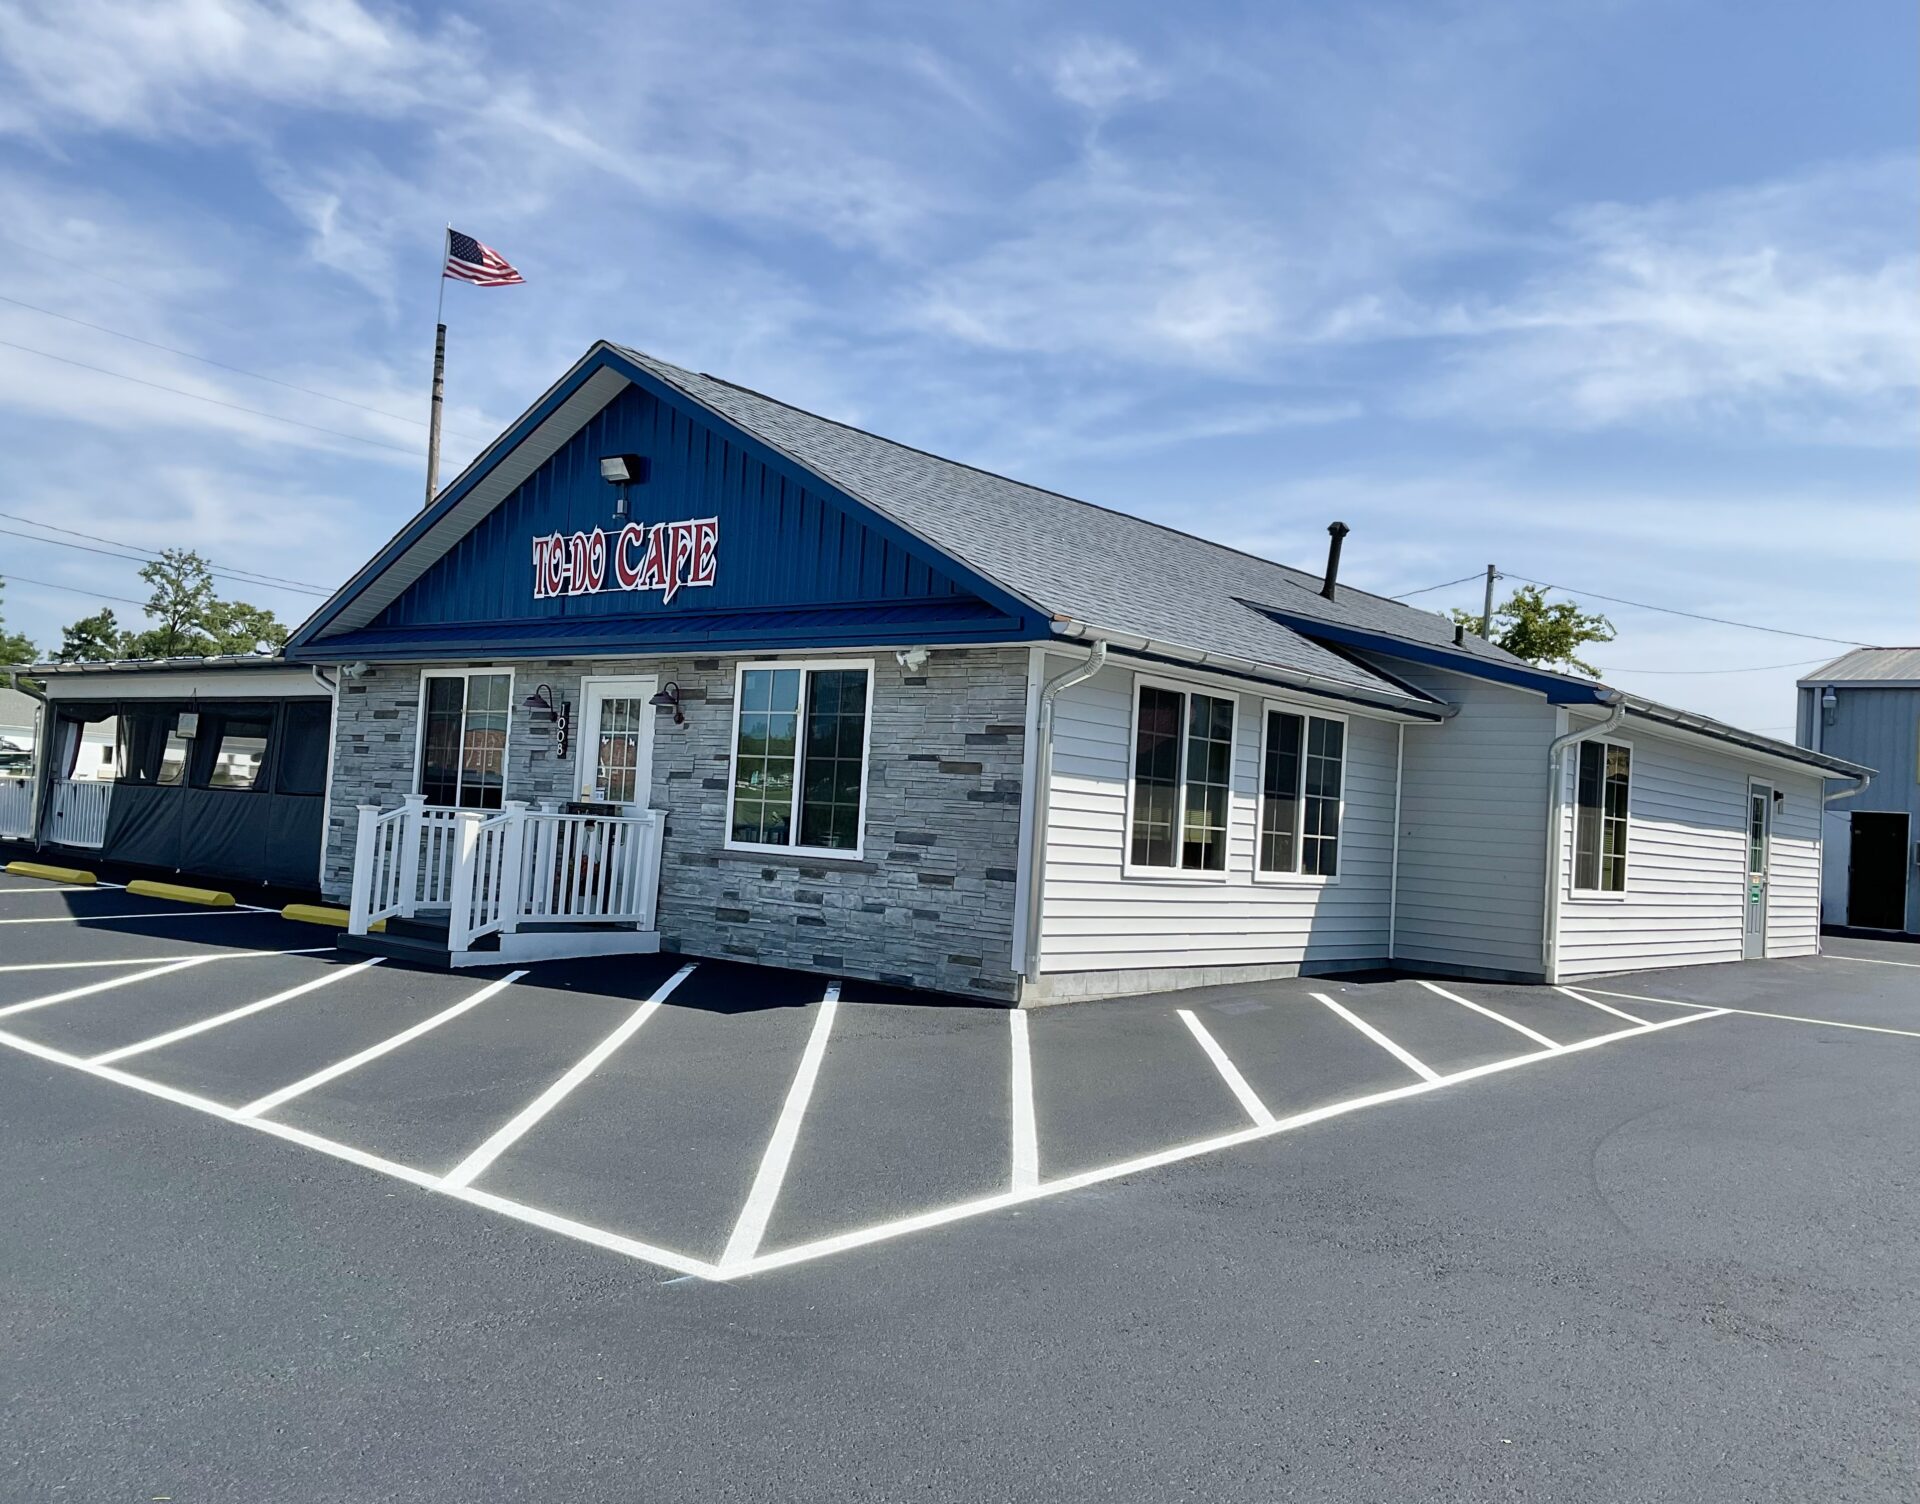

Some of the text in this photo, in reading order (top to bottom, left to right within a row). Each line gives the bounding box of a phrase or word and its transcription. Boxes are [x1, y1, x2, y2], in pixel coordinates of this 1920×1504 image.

[533, 516, 718, 605] TO-DO CAFE
[556, 703, 566, 756] 1008
